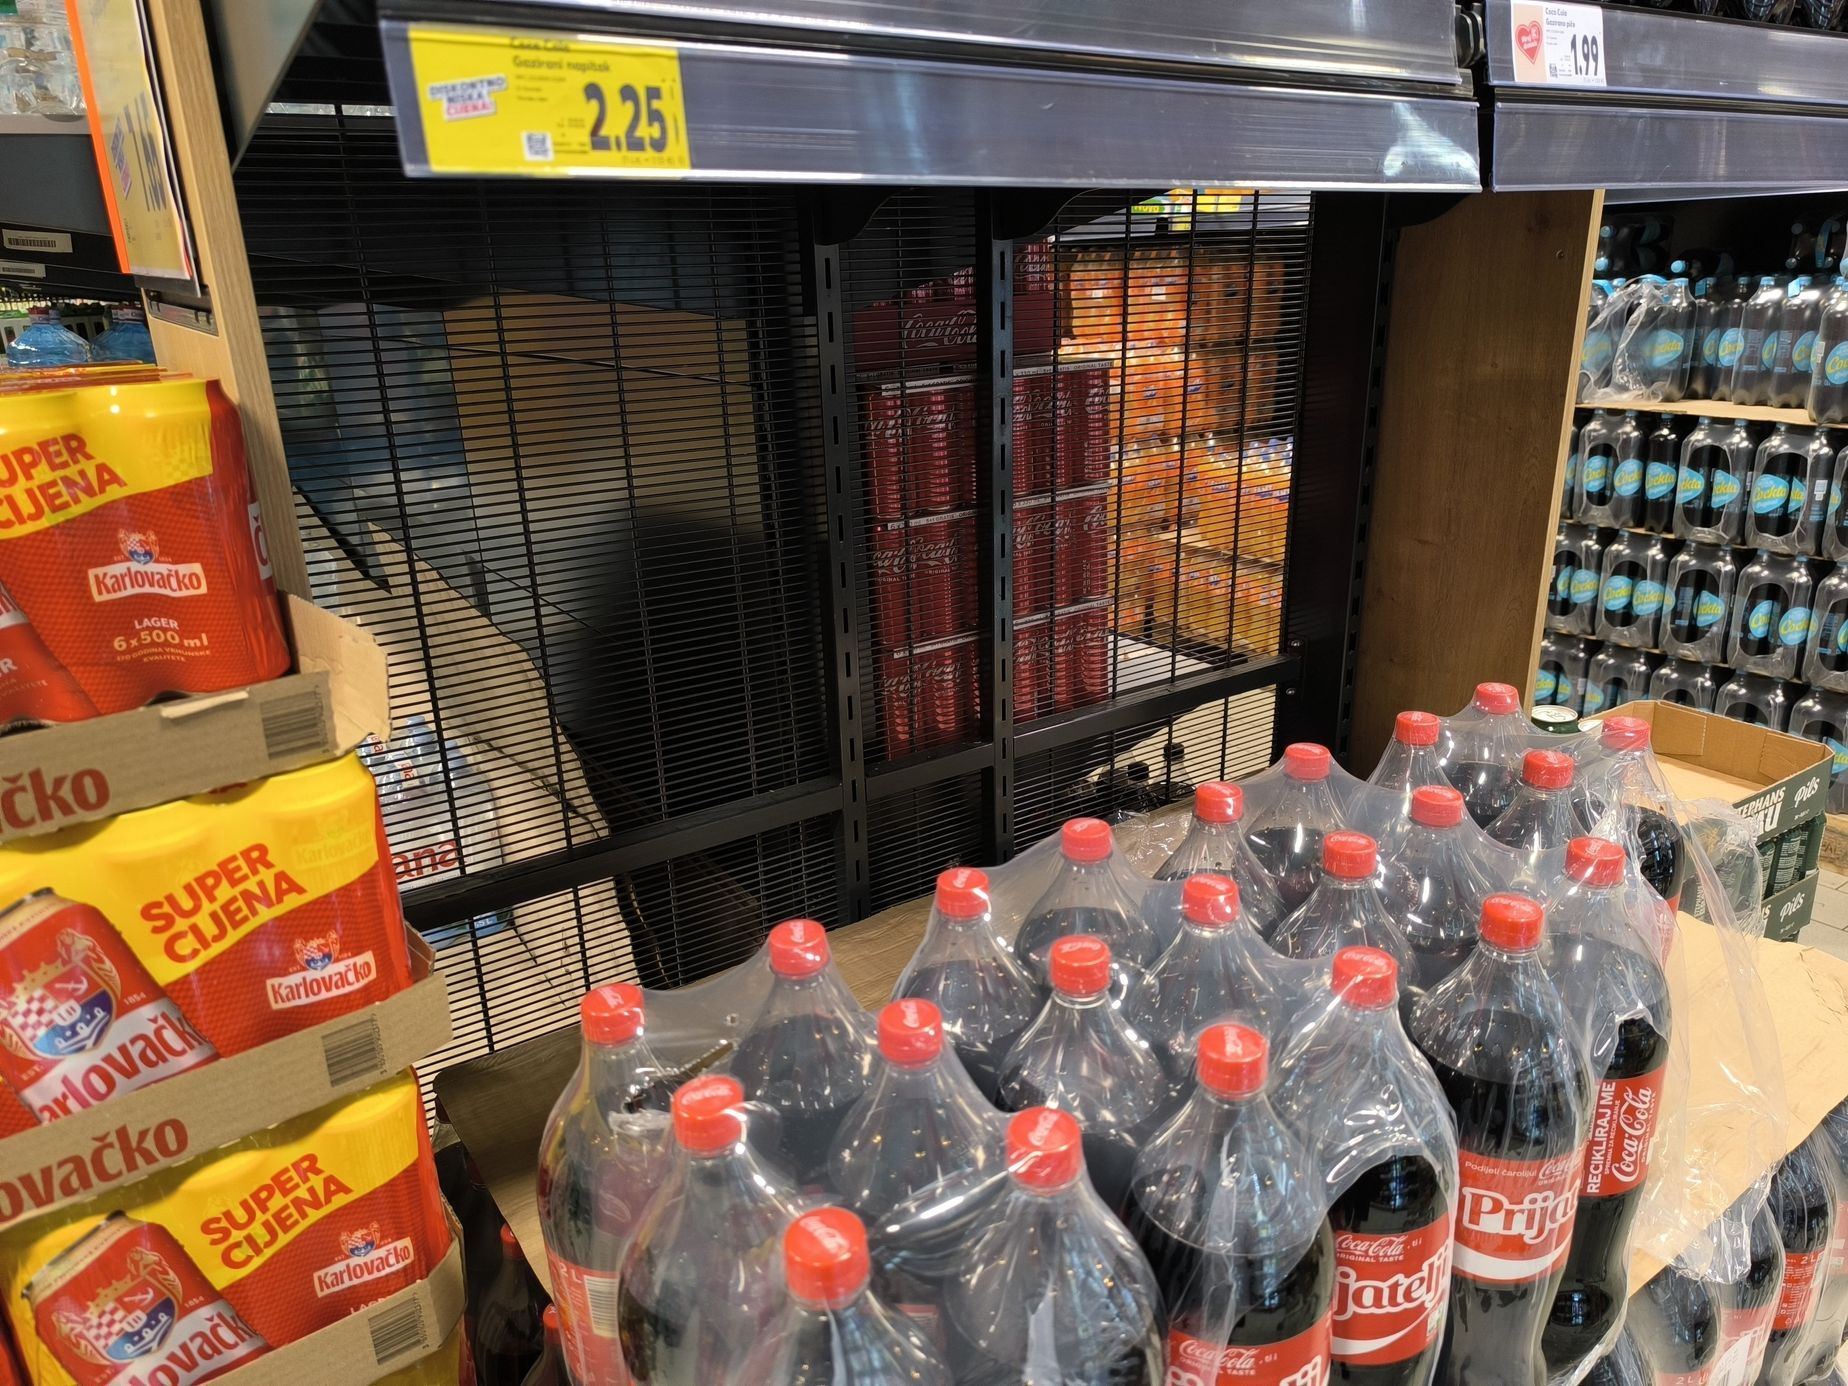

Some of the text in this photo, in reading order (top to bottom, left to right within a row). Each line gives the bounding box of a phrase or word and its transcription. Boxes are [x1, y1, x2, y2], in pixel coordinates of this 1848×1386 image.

[1571, 34, 1599, 76] 1.99
[584, 82, 668, 153] 2.25
[94, 566, 202, 596] Karlovačko
[113, 636, 127, 651] 6
[140, 630, 180, 644] 500
[183, 633, 208, 648] ml
[134, 617, 179, 630] LAGER
[1736, 786, 1786, 817] TEPHANS
[1794, 776, 1820, 808] Pils
[140, 843, 276, 934] SUPER
[1780, 892, 1805, 922] Pils
[163, 870, 308, 964] CIJENA
[270, 960, 372, 1004] Karlovačko
[1587, 1082, 1616, 1193] RECIKLIRAJ ME
[1612, 1087, 1652, 1182] Coca-Cola
[200, 1153, 326, 1246] SUPER
[221, 1174, 354, 1270] CIJENA
[1336, 1234, 1408, 1256] Coca-Cola
[1379, 1255, 1404, 1263] TASTE
[1800, 1256, 1808, 1265] 2
[317, 1245, 411, 1293] Karlovačko
[1227, 1368, 1256, 1376] TASTE
